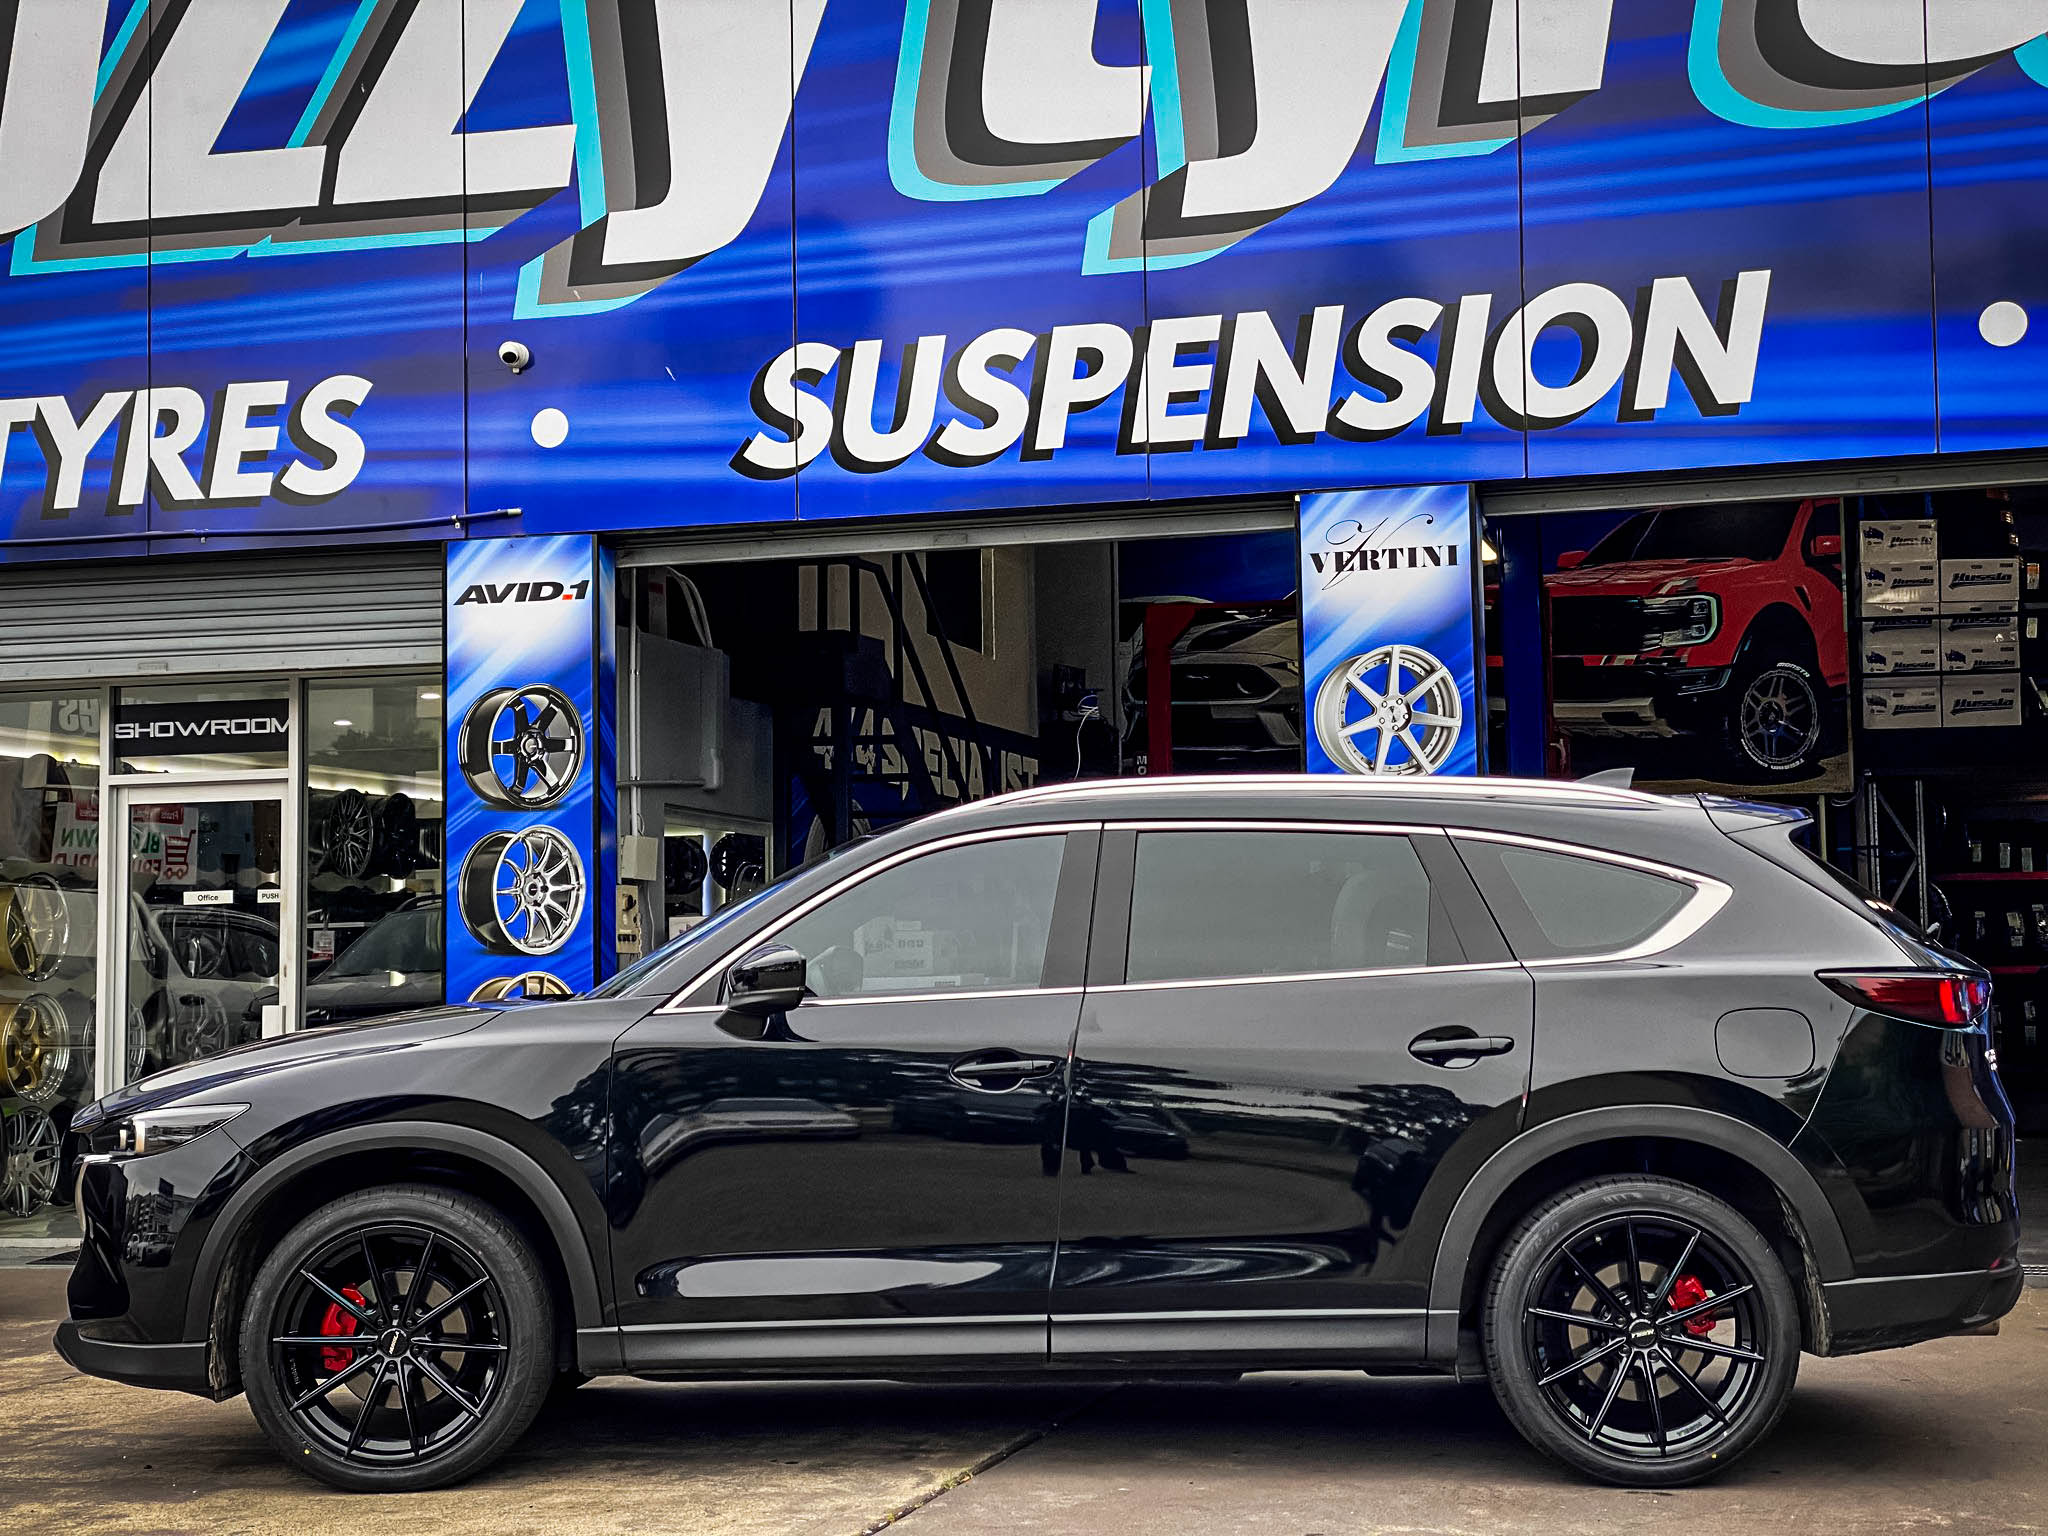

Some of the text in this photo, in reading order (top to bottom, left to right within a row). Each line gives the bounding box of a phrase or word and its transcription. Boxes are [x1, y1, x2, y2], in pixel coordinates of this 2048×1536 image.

[734, 269, 1772, 477] SUSPENSION
[1309, 545, 1460, 574] VERTINI
[453, 579, 591, 606] AVID.1
[114, 717, 289, 739] SHOWROOM
[197, 894, 219, 902] Office
